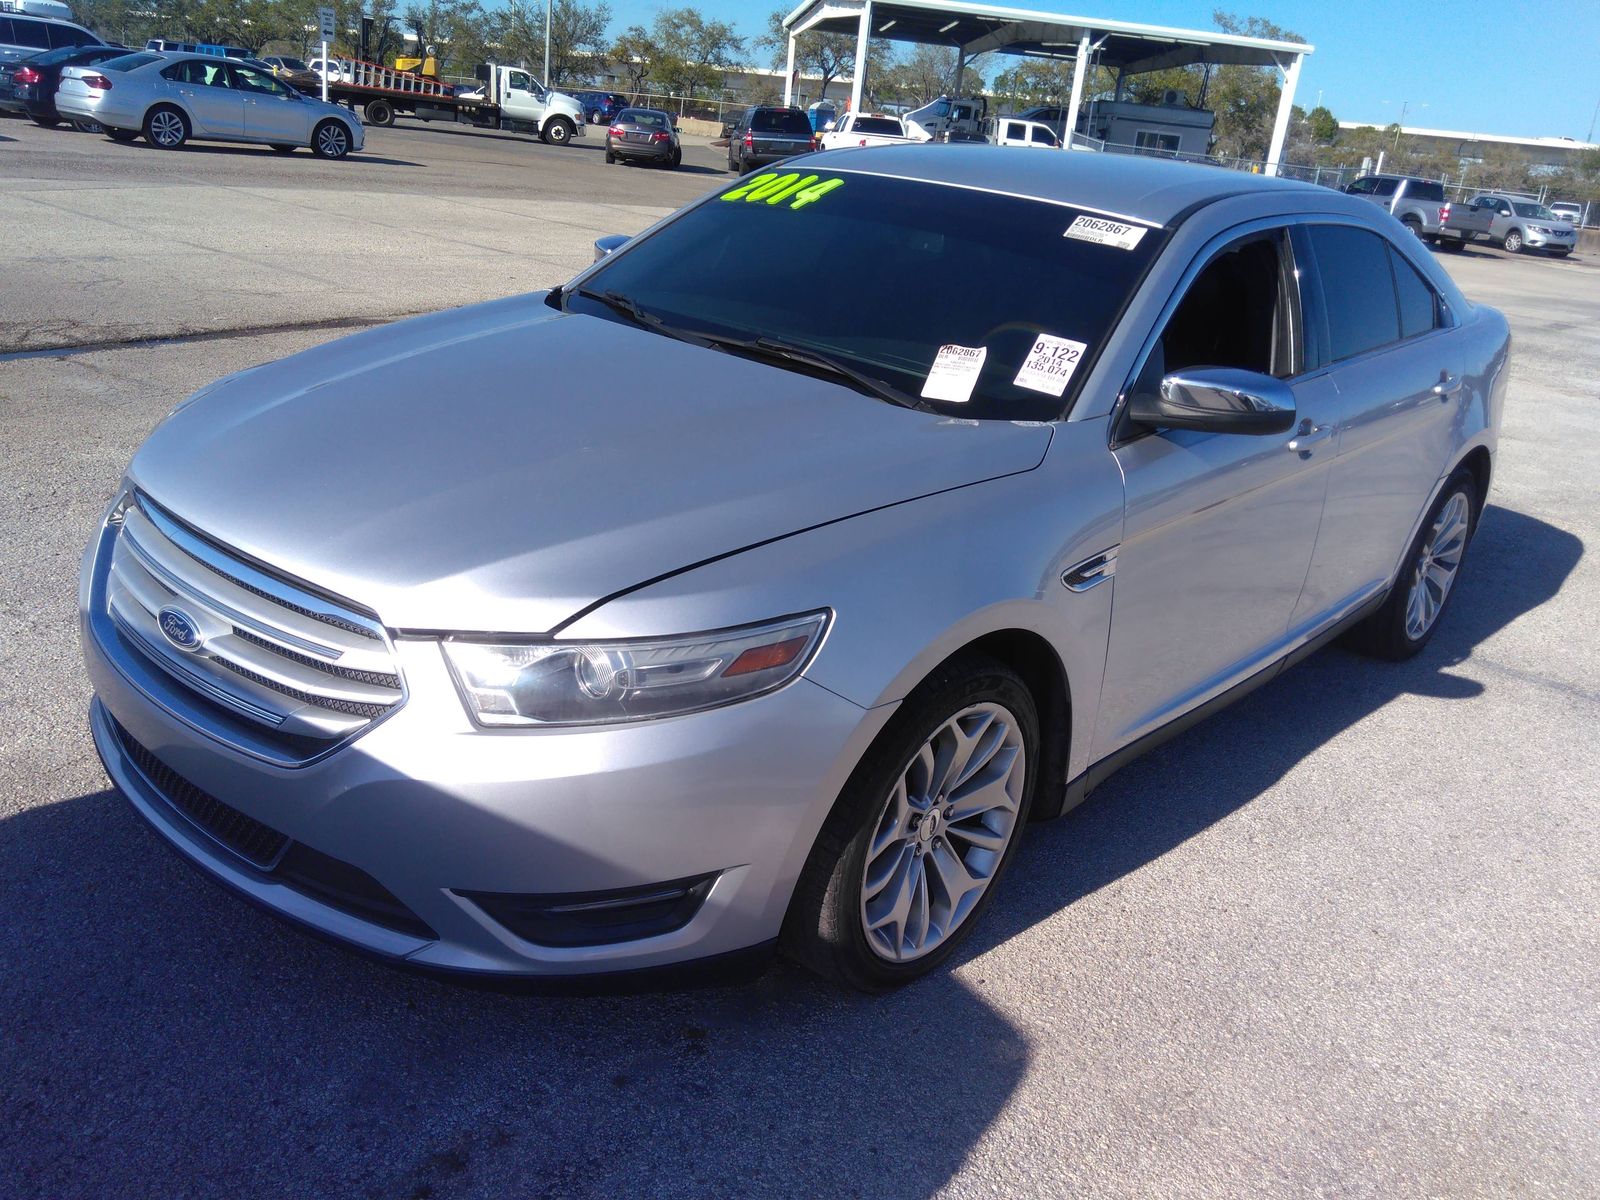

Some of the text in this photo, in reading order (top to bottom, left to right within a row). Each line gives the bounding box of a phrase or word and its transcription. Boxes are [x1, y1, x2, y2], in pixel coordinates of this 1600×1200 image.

[719, 172, 845, 210] 2014
[1075, 217, 1132, 236] 2062867
[940, 345, 982, 358] 2062867
[1037, 355, 1063, 367] 2014
[164, 614, 188, 641] Ford
